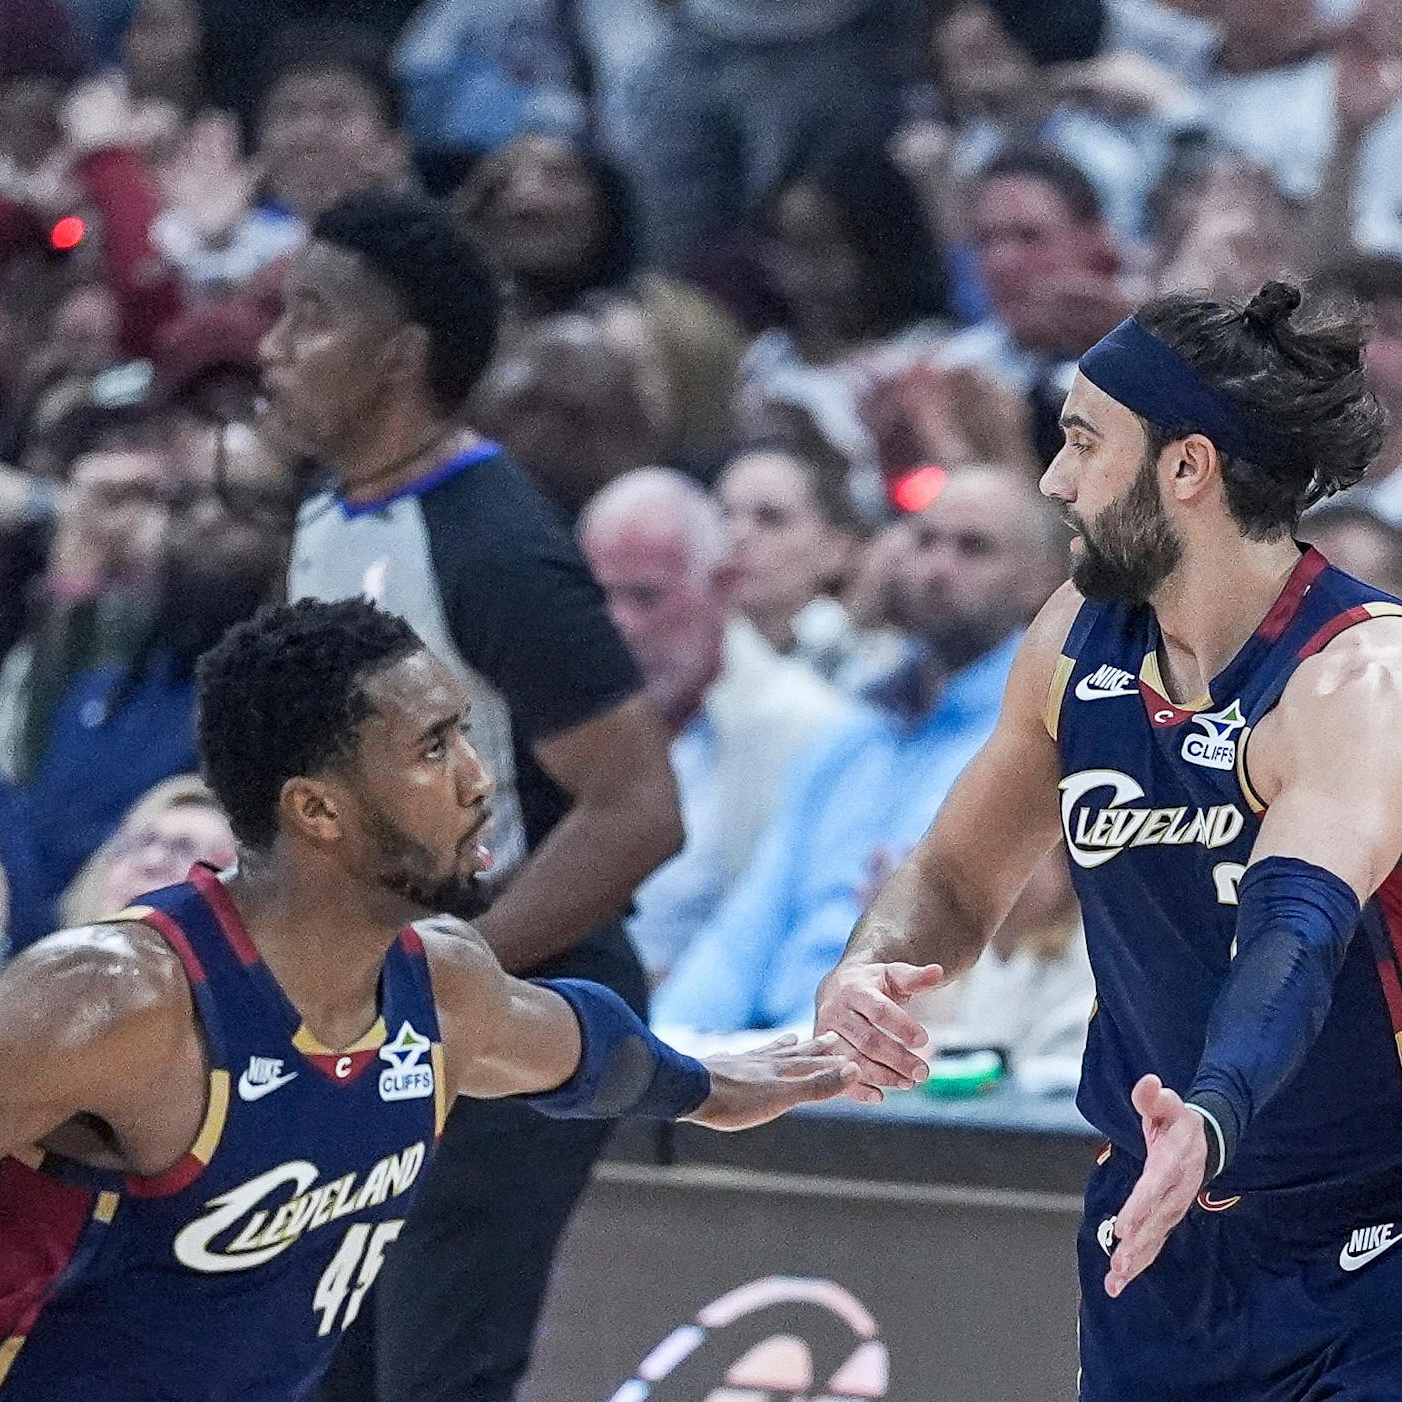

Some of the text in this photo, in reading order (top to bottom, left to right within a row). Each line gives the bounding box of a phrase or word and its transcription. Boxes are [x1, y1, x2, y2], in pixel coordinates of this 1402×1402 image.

[1089, 664, 1135, 690] NIKE
[1187, 740, 1234, 764] CLIFFS
[248, 1055, 284, 1083] NIKE
[382, 1072, 430, 1093] CLIFFS
[173, 1140, 426, 1273] CLEVELAND
[1348, 1222, 1395, 1253] NIKE
